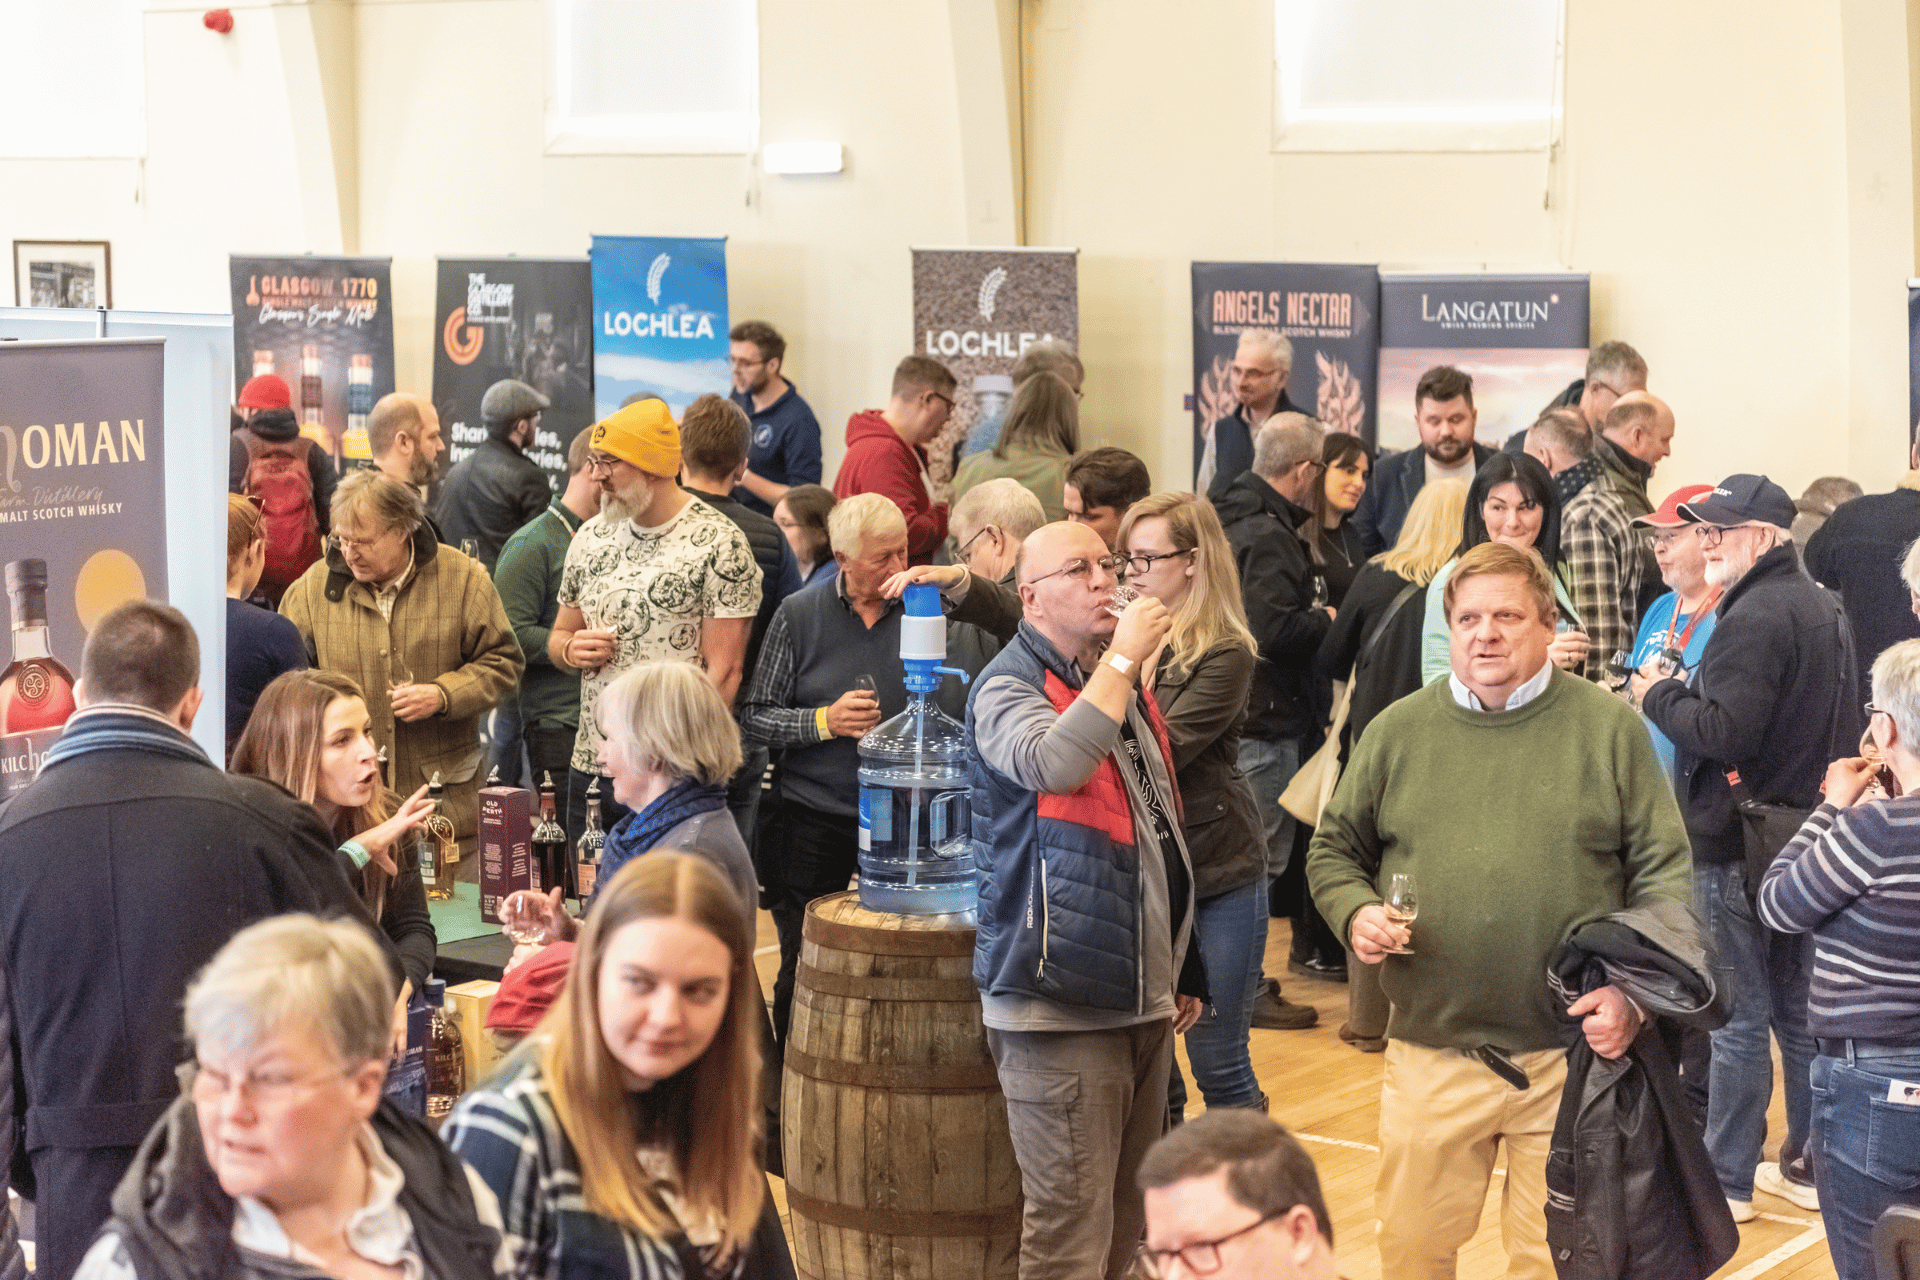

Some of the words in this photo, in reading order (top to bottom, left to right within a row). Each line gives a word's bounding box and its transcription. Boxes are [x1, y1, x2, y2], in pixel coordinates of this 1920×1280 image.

[261, 275, 334, 296] GLASGOW
[342, 277, 378, 298] 1770
[1287, 292, 1351, 327] NECTAR
[1422, 294, 1548, 322] LANGATUN
[604, 311, 715, 339] LOCHLEA
[926, 330, 1053, 357] LOCHLE
[32, 485, 103, 506] Distillery
[0, 510, 28, 523] MALT
[33, 506, 74, 520] SCOTCH
[78, 502, 122, 516] WHISKY
